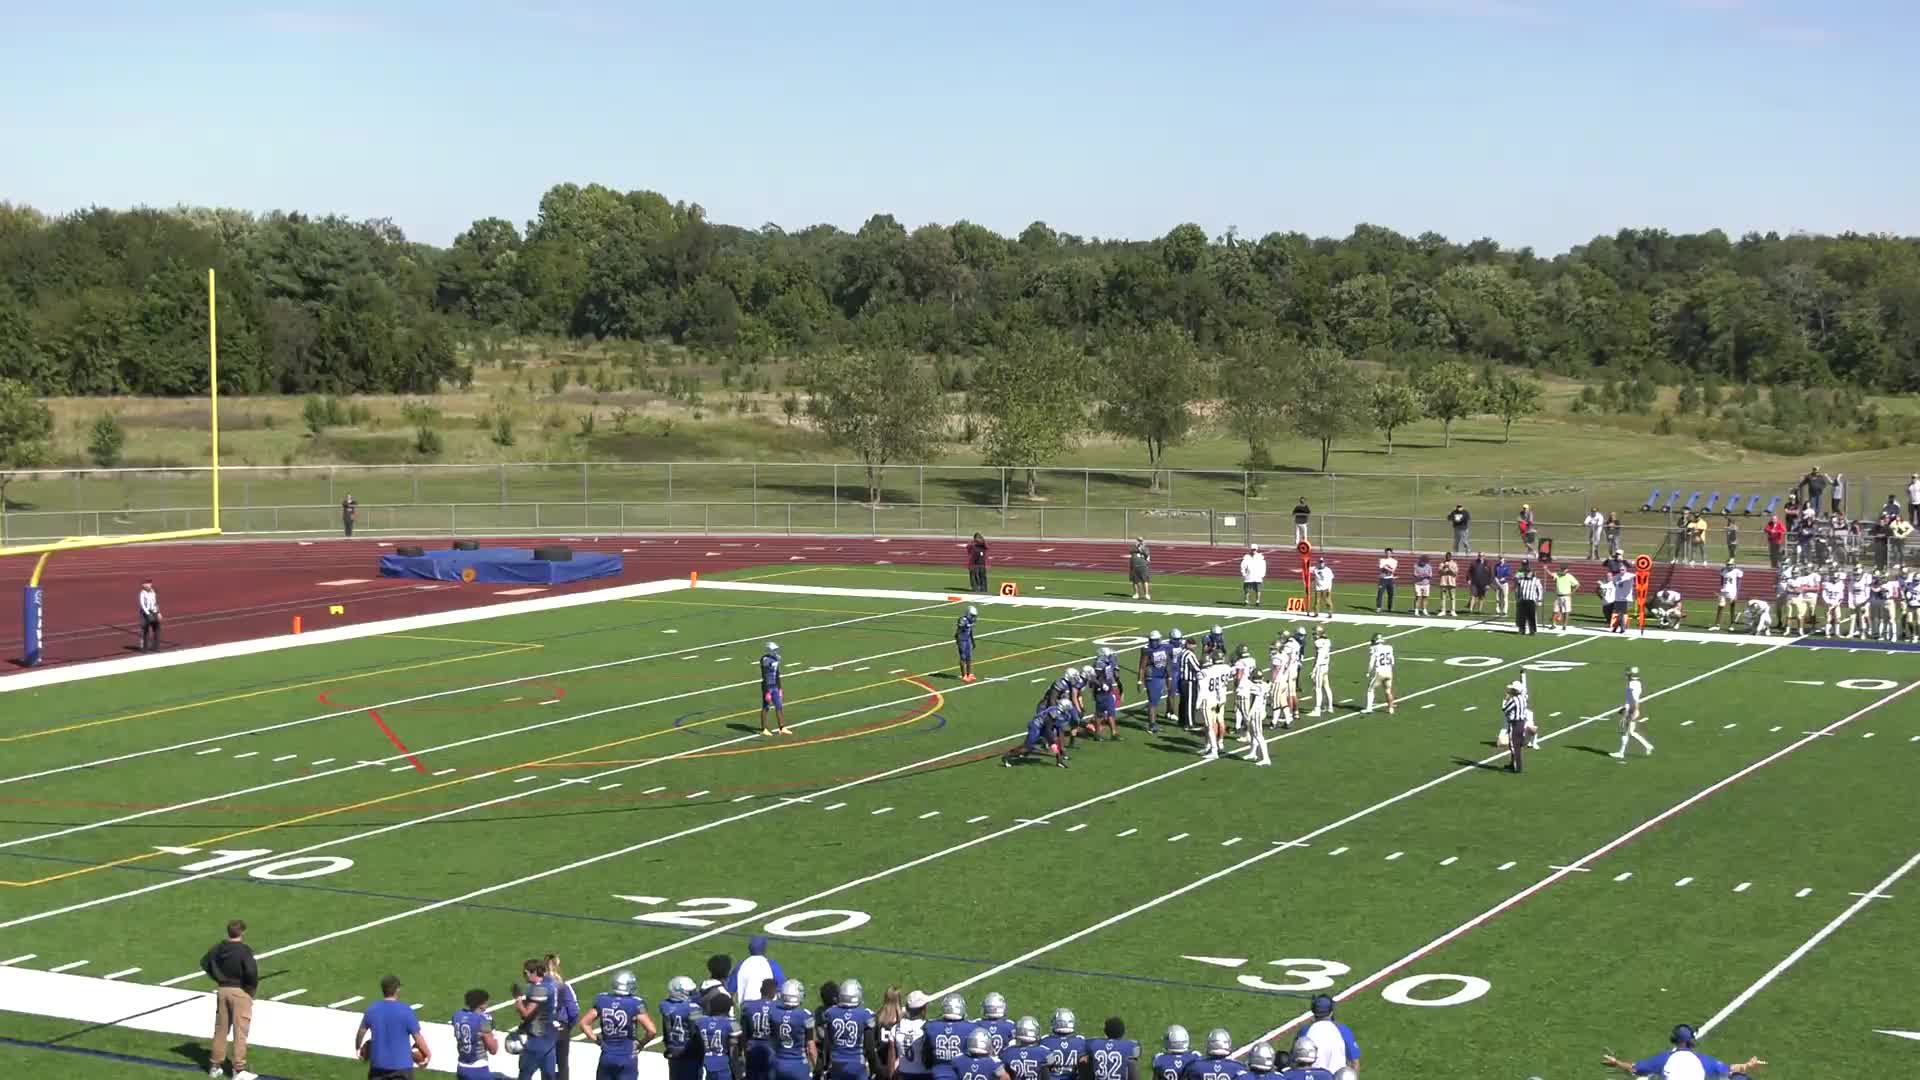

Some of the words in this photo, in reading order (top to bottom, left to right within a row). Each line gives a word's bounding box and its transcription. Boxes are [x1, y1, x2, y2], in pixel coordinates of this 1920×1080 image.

[1002, 583, 1014, 596] G
[1288, 599, 1302, 611] 10
[602, 1007, 628, 1037] 52
[832, 1018, 858, 1048] 23
[701, 1029, 724, 1056] 14
[935, 1034, 961, 1060] 66
[1095, 1050, 1123, 1080] 32
